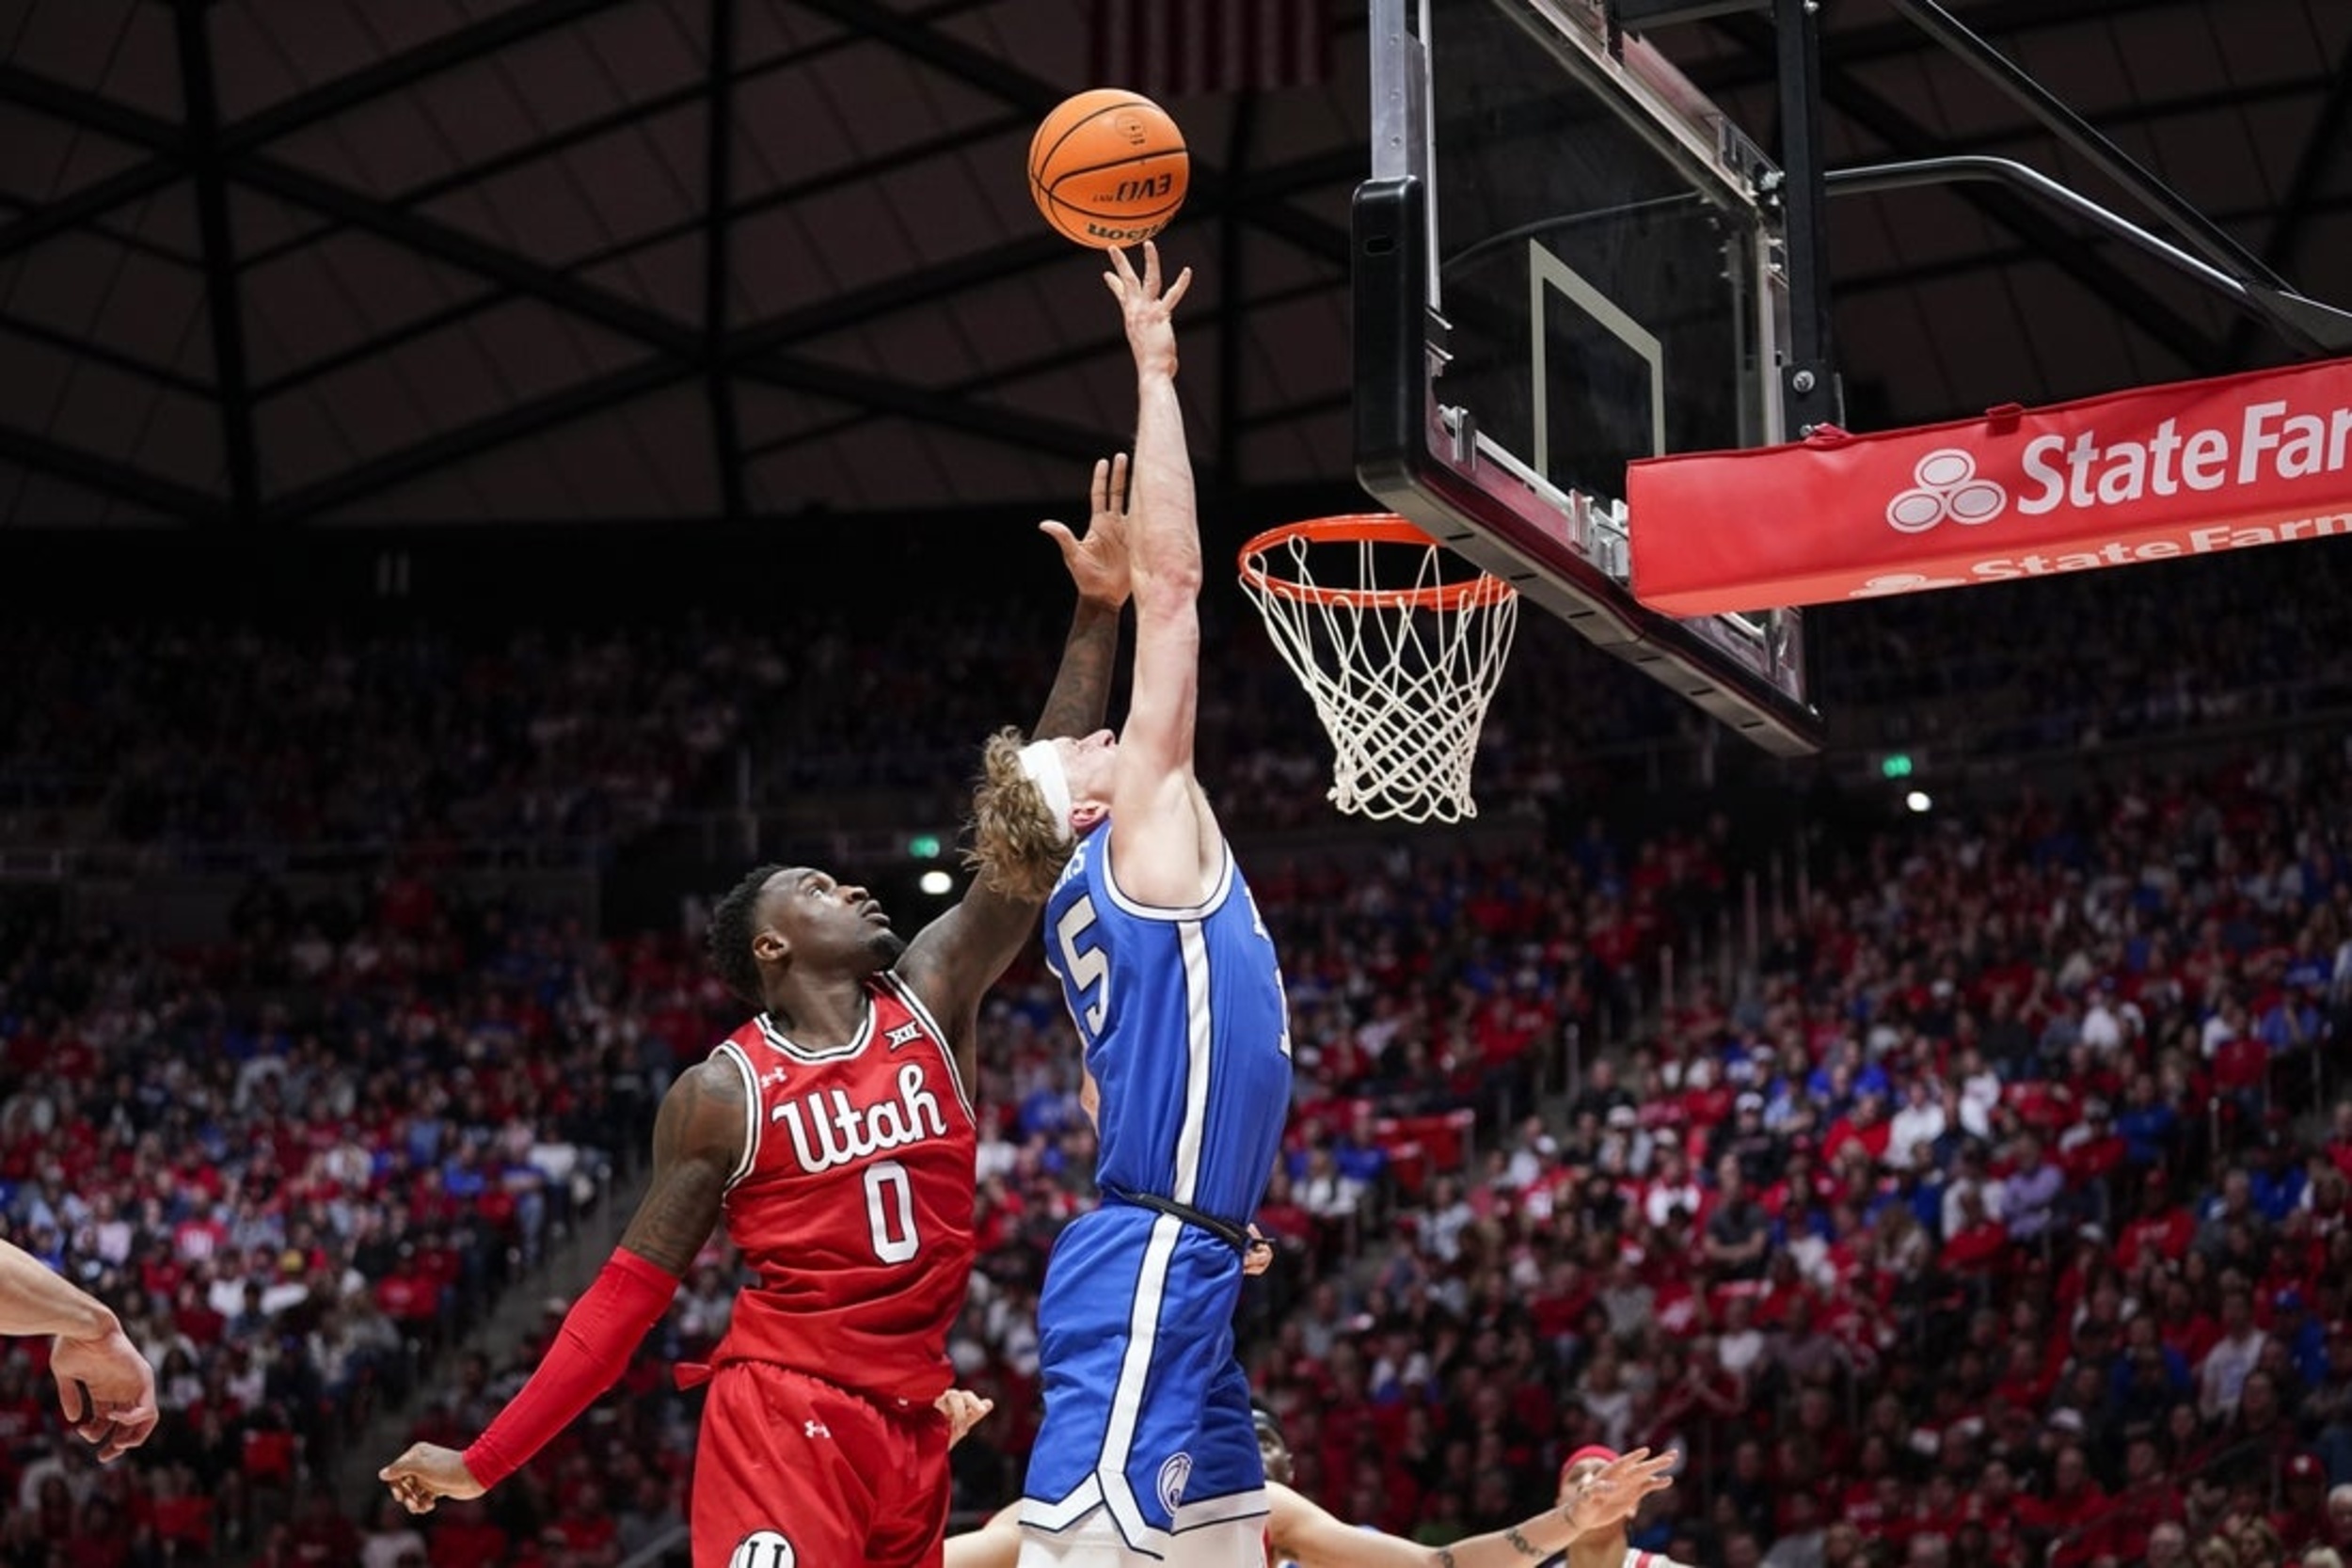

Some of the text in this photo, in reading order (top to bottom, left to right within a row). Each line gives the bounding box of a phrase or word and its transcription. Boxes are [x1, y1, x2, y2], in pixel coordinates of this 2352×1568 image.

[2017, 417, 2229, 515] State
[1971, 538, 2182, 582] State
[1046, 894, 1110, 1051] 5
[771, 1063, 947, 1173] Utah
[864, 1160, 920, 1264] 0
